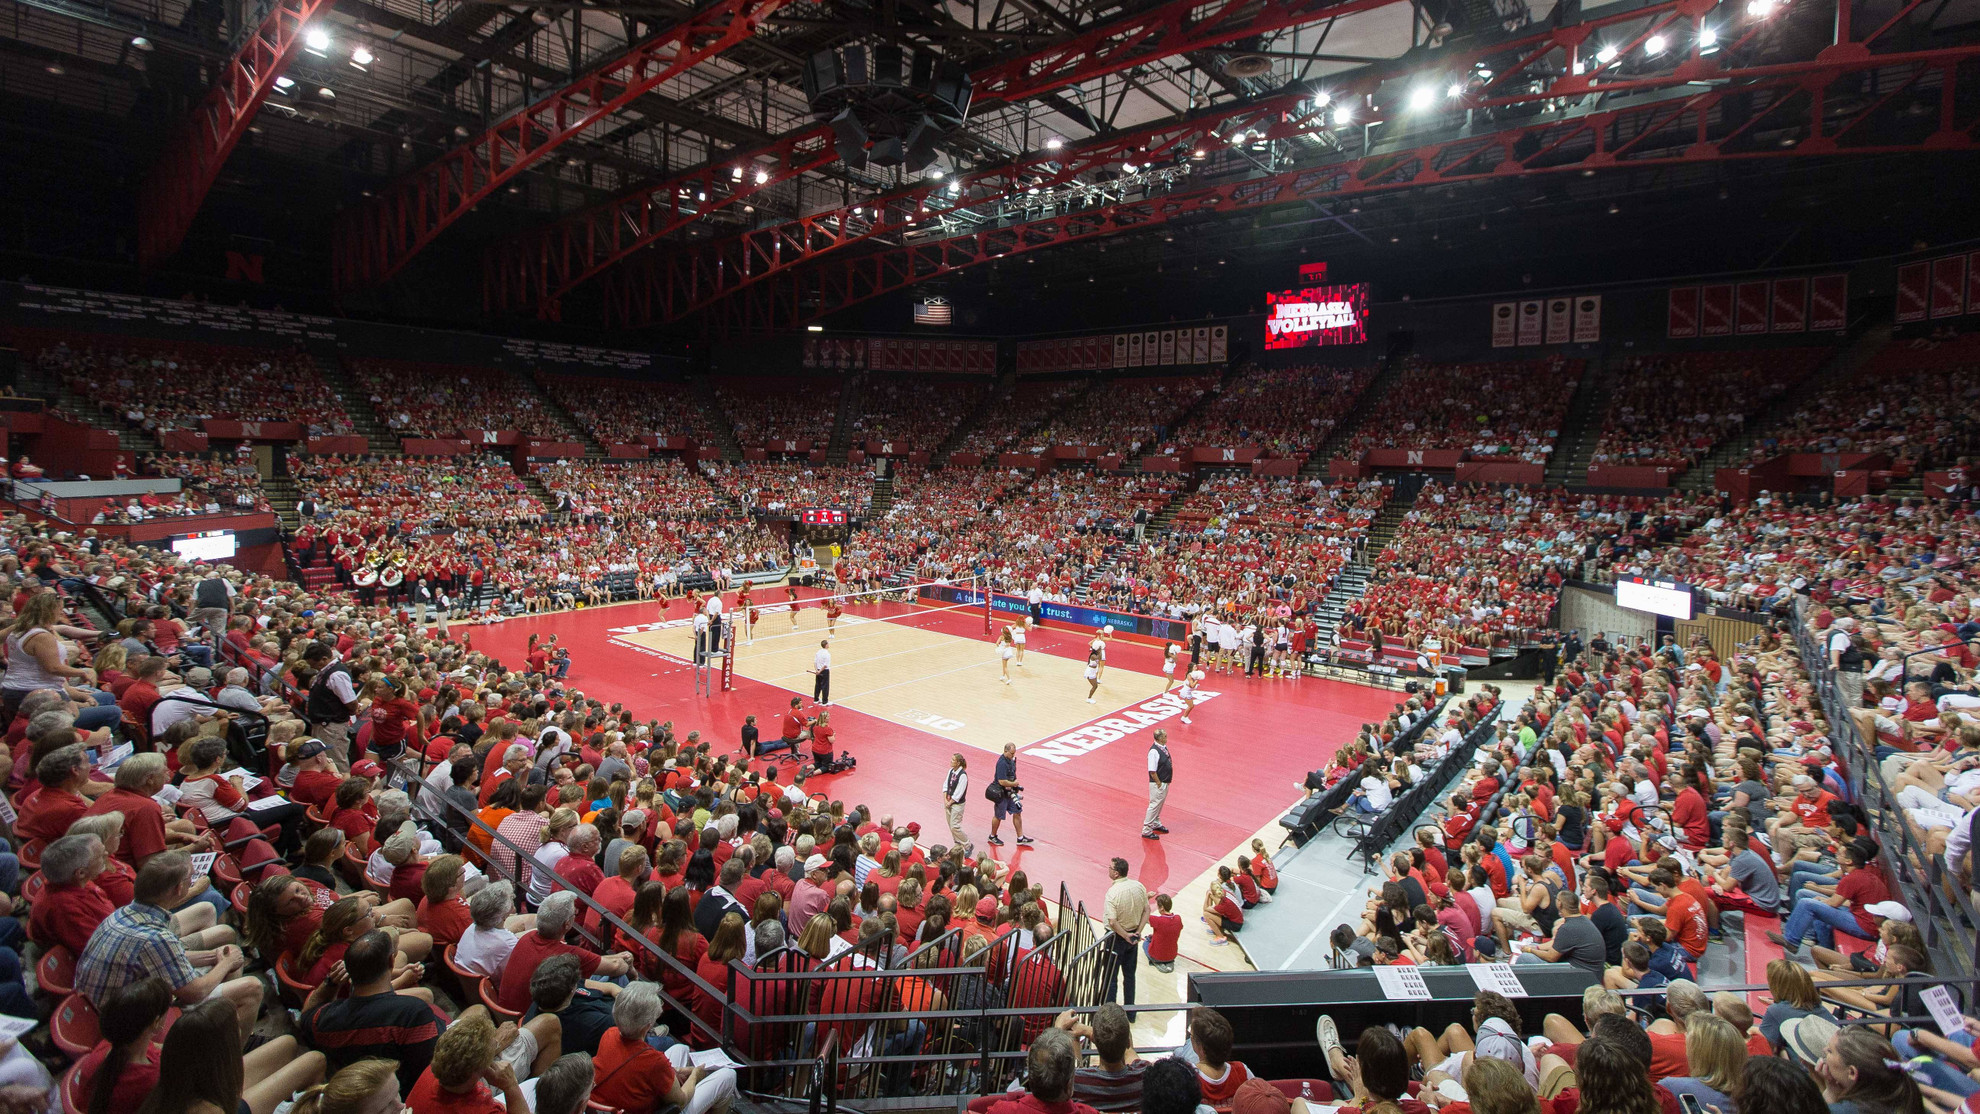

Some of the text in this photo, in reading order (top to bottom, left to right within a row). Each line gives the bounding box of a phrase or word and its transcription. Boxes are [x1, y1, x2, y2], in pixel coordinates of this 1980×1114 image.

[1276, 302, 1352, 319] NEBRASKA
[1268, 313, 1357, 335] VOLLEYBALL
[241, 422, 261, 436] N
[482, 431, 498, 443] N
[656, 437, 668, 448] N
[784, 440, 796, 451] N
[881, 442, 893, 453] N
[1077, 447, 1088, 458] N
[1222, 449, 1236, 461] N
[1407, 451, 1424, 465] N
[1820, 455, 1841, 473] N
[930, 585, 942, 600] N
[956, 592, 963, 601] A
[1009, 603, 1025, 611] you
[1047, 607, 1073, 619] trust.
[1107, 618, 1134, 628] NEBRASKA
[1151, 619, 1170, 639] N
[606, 638, 632, 648] TERRY
[658, 655, 693, 666] COURT
[1022, 689, 1222, 765] NEBRASKA
